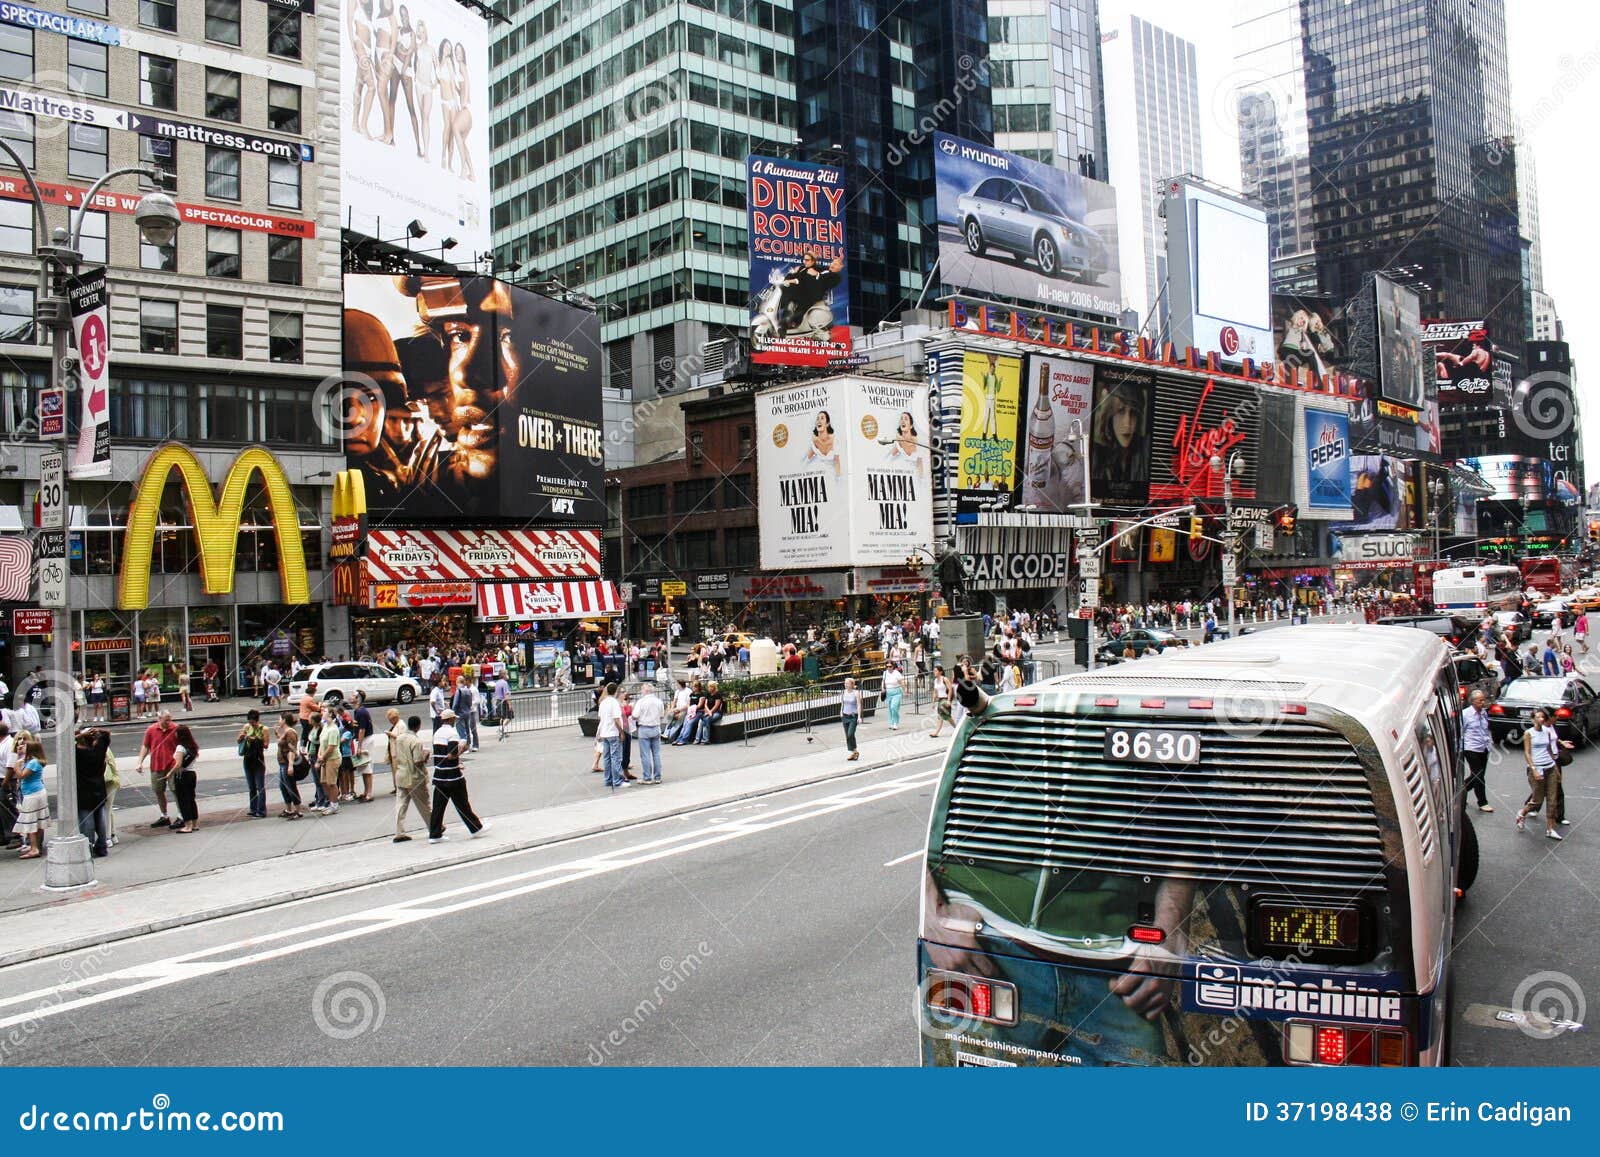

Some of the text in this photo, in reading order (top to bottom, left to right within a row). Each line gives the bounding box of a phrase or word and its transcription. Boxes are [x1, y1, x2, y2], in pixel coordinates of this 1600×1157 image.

[157, 120, 293, 157] mattress.com
[961, 146, 1009, 170] HYUNDAI
[752, 160, 839, 184] A Runaway Hit!
[752, 176, 844, 217] DIRTY
[754, 211, 844, 245] ROTTEN
[754, 237, 844, 261] SCOUNDRELS
[70, 278, 105, 299] INFORMATION
[79, 293, 100, 308] CENTER
[1037, 283, 1121, 315] All-new 2006 Sonata
[1053, 372, 1091, 386] CRITICS AGREE!
[1458, 378, 1490, 394] Spike
[788, 389, 809, 402] MOST
[812, 387, 827, 398] FUN
[868, 385, 915, 400] WORLDWIDE
[771, 406, 783, 416] ON
[518, 414, 603, 459] OVER THERE
[1320, 423, 1337, 443] diet
[964, 438, 1014, 452] everybody
[1310, 437, 1345, 469] PEPSI
[42, 459, 61, 470] SPEED
[963, 453, 1013, 478] chris
[44, 472, 59, 482] LIMIT
[536, 474, 588, 488] PREMIERES JULY 27
[43, 484, 61, 507] 30
[779, 475, 828, 507] MAMMA
[867, 473, 916, 502] MAMMA
[790, 505, 819, 535] MIA!
[879, 503, 908, 530] MIA!
[49, 534, 64, 543] BIKE
[48, 545, 64, 554] LANE
[388, 551, 431, 562] FRIDAY'S
[468, 550, 508, 561] FRIDAY'S
[542, 550, 583, 561] FRIDAY'S
[697, 574, 728, 583] CAMERAS
[45, 590, 60, 600] ONLY
[21, 617, 47, 625] ANYTIME
[27, 610, 51, 618] STANDING
[1110, 731, 1198, 763] 8630
[1269, 907, 1338, 945] M20
[1240, 974, 1401, 1020] machine
[944, 1031, 1082, 1064] machineclothingcompany.com
